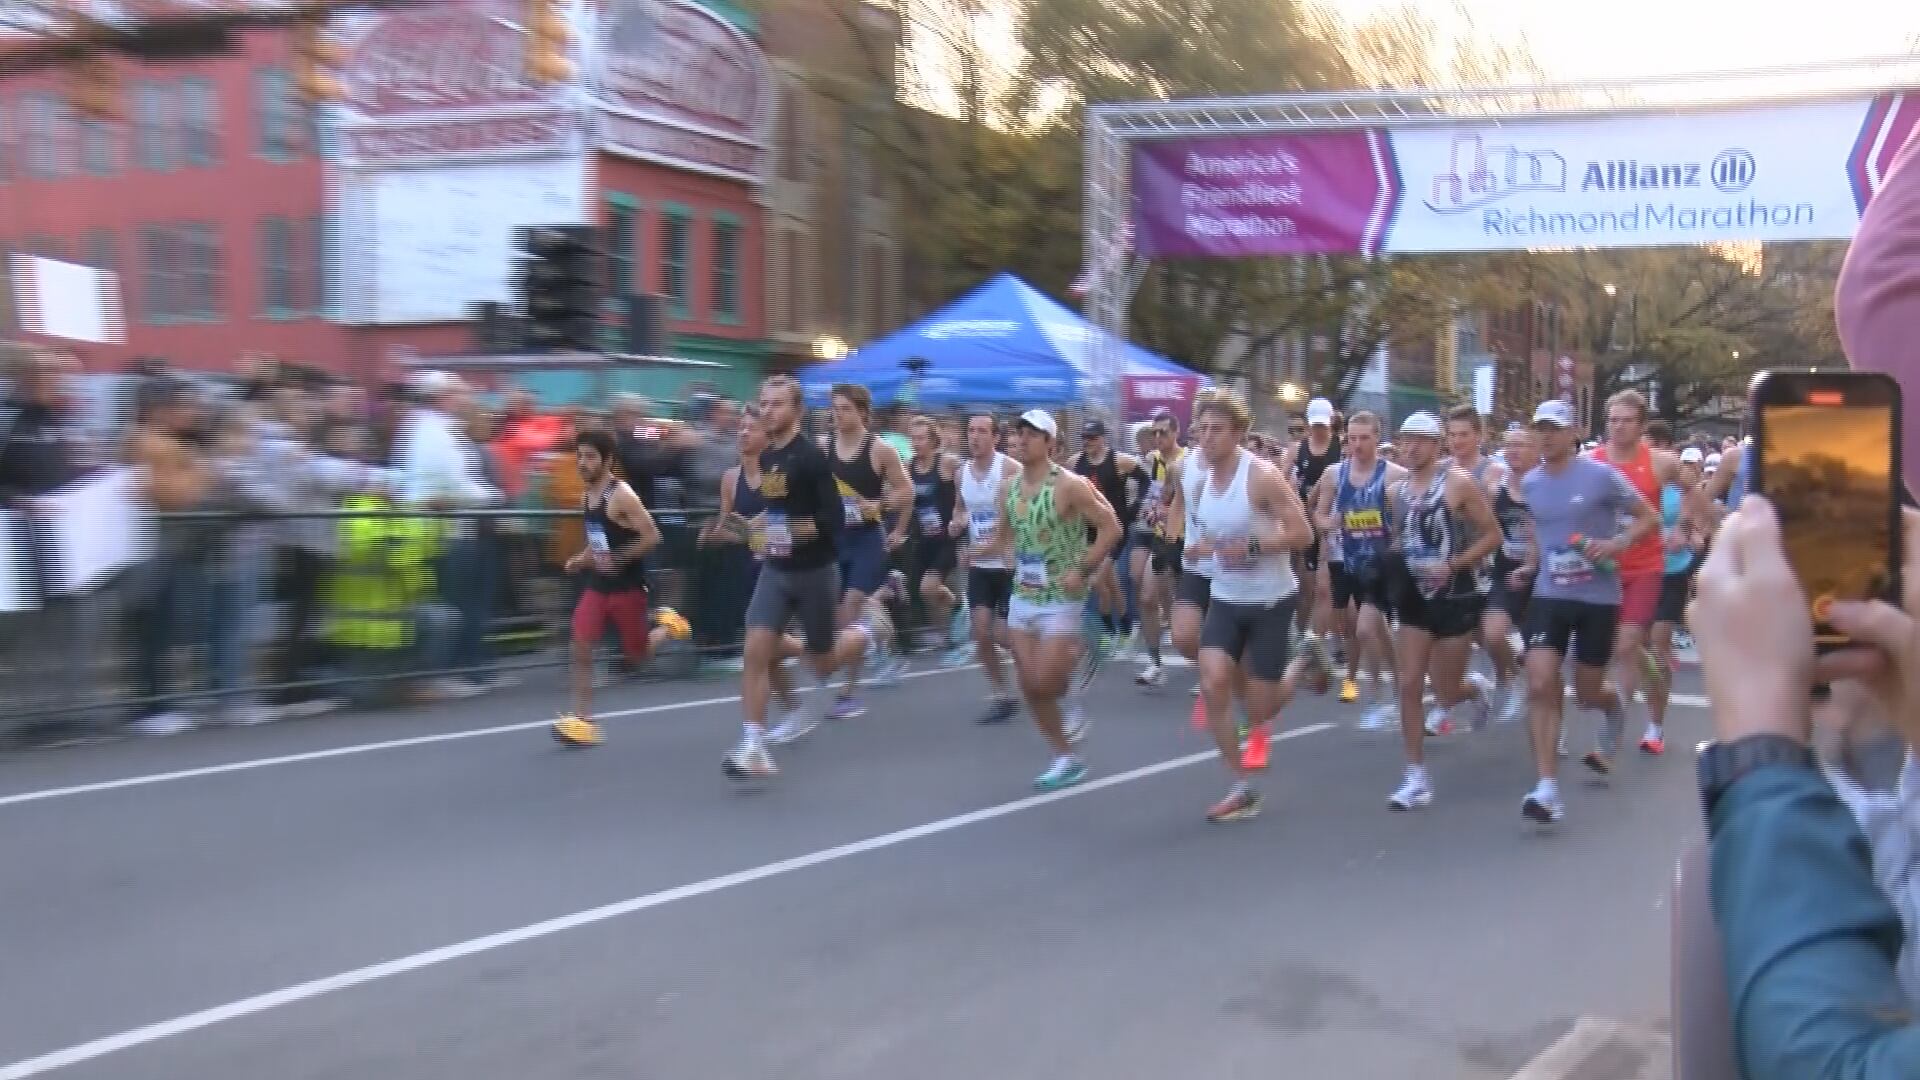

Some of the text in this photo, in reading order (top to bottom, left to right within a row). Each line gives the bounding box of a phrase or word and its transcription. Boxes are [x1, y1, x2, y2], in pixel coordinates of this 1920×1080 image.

[1185, 149, 1300, 177] America's
[1580, 159, 1701, 192] Allianz
[1182, 180, 1303, 206] Friendliest
[1186, 213, 1297, 236] Marathon
